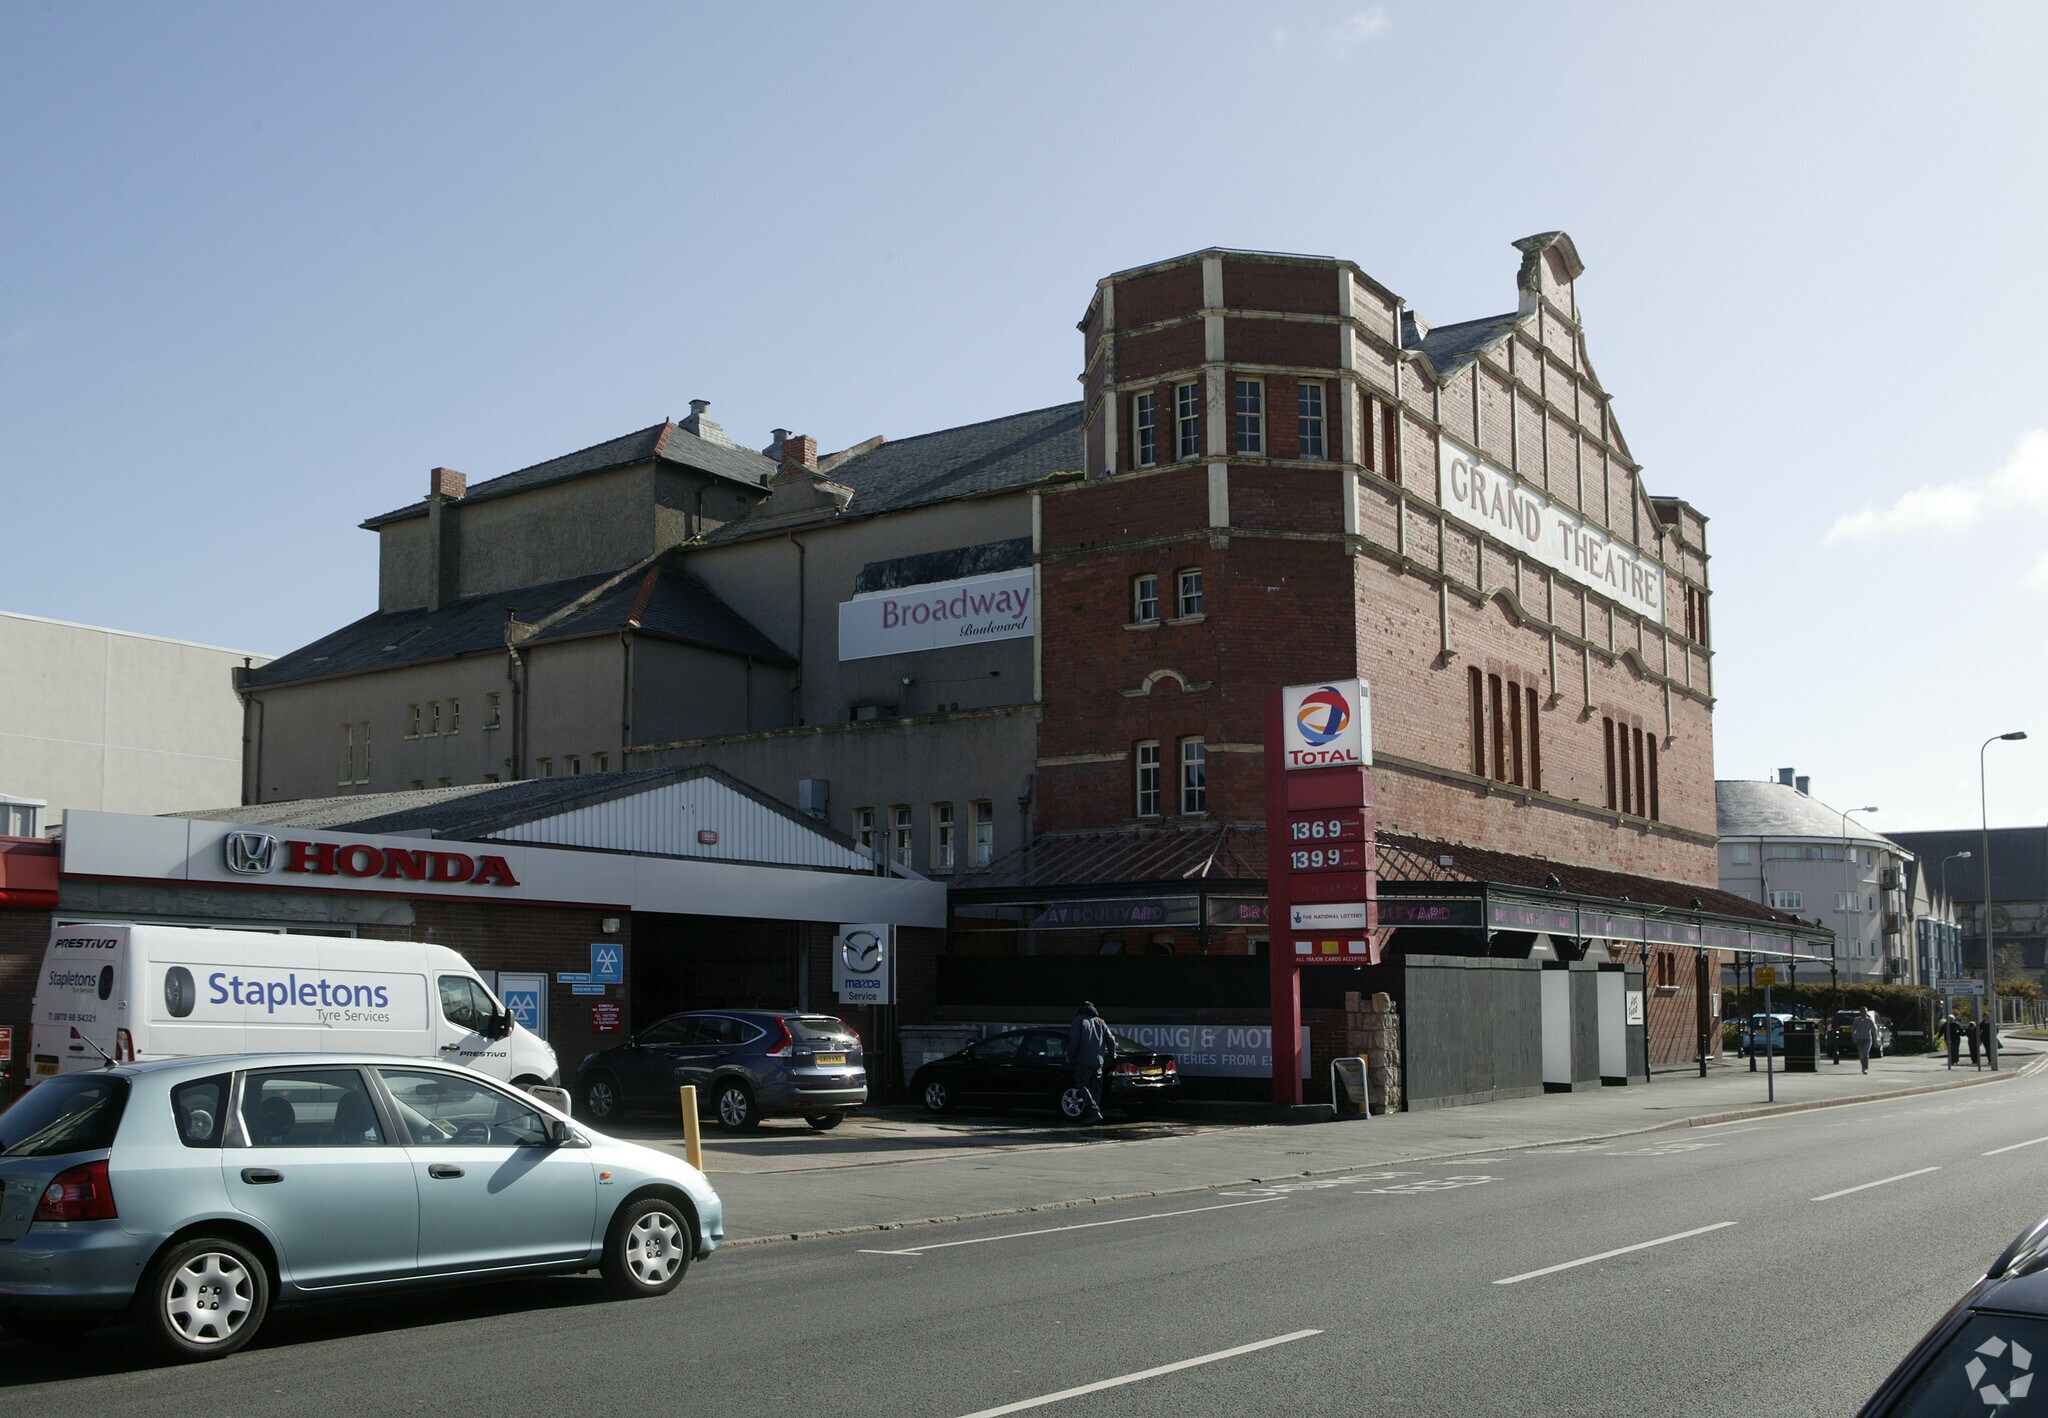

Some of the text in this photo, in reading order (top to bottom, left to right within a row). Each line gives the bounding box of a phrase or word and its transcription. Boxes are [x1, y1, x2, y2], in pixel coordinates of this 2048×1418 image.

[1451, 457, 1658, 609] GRAND THEATRE
[882, 586, 1031, 629] Broadway
[959, 616, 1029, 638] Boulevard
[1288, 748, 1359, 767] TOTAL
[1291, 819, 1341, 840] 136.9
[283, 839, 521, 887] HONDA
[1290, 849, 1340, 869] 139.9
[1072, 905, 1163, 922] BOULEVARD
[48, 969, 97, 990] Stapletons
[208, 972, 389, 1014] Stapletons
[848, 991, 877, 1001] Service
[315, 1009, 390, 1024] Tyre Services
[1201, 1027, 1216, 1048] &
[1227, 1027, 1272, 1049] MOT
[1221, 1054, 1257, 1066] FROM
